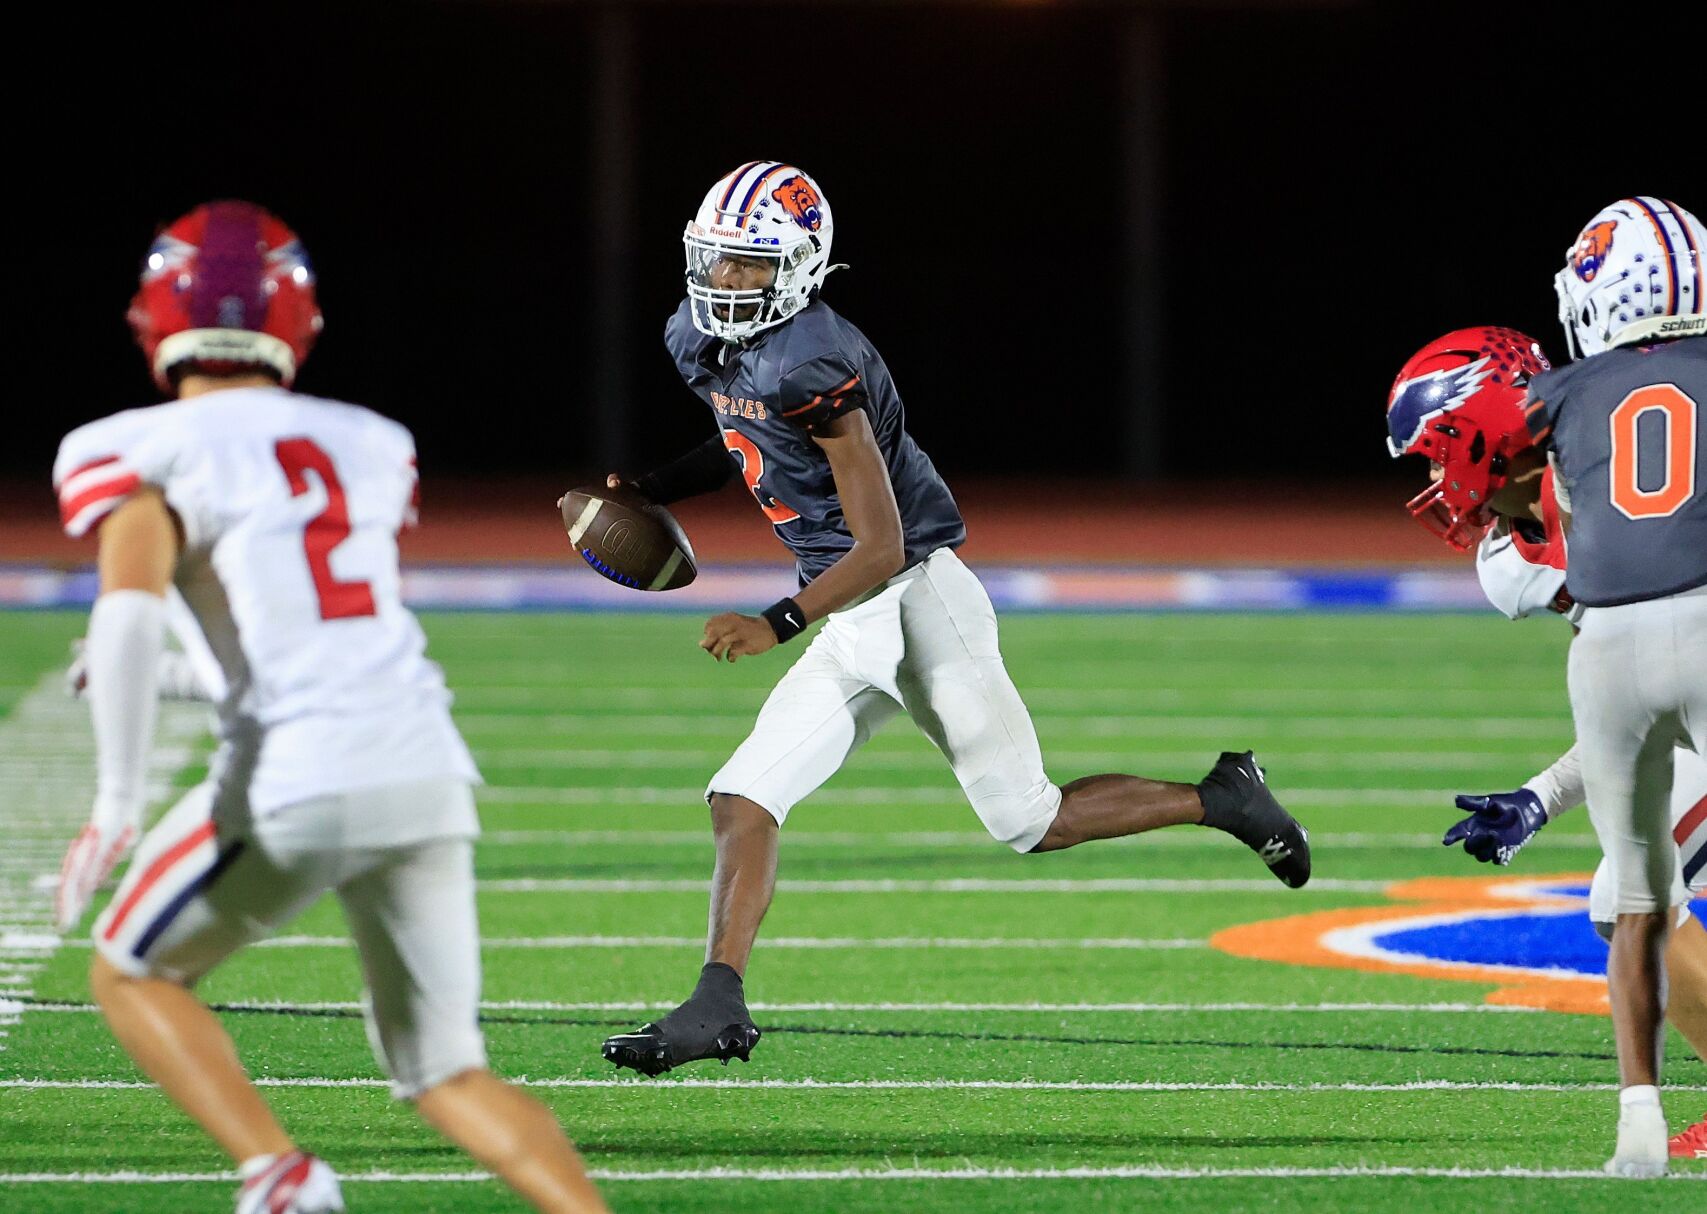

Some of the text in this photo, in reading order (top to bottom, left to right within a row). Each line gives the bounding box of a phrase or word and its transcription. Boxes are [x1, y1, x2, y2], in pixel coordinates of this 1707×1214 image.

[709, 226, 742, 239] Riddell
[1609, 382, 1698, 521] 0
[274, 437, 377, 620] 2
